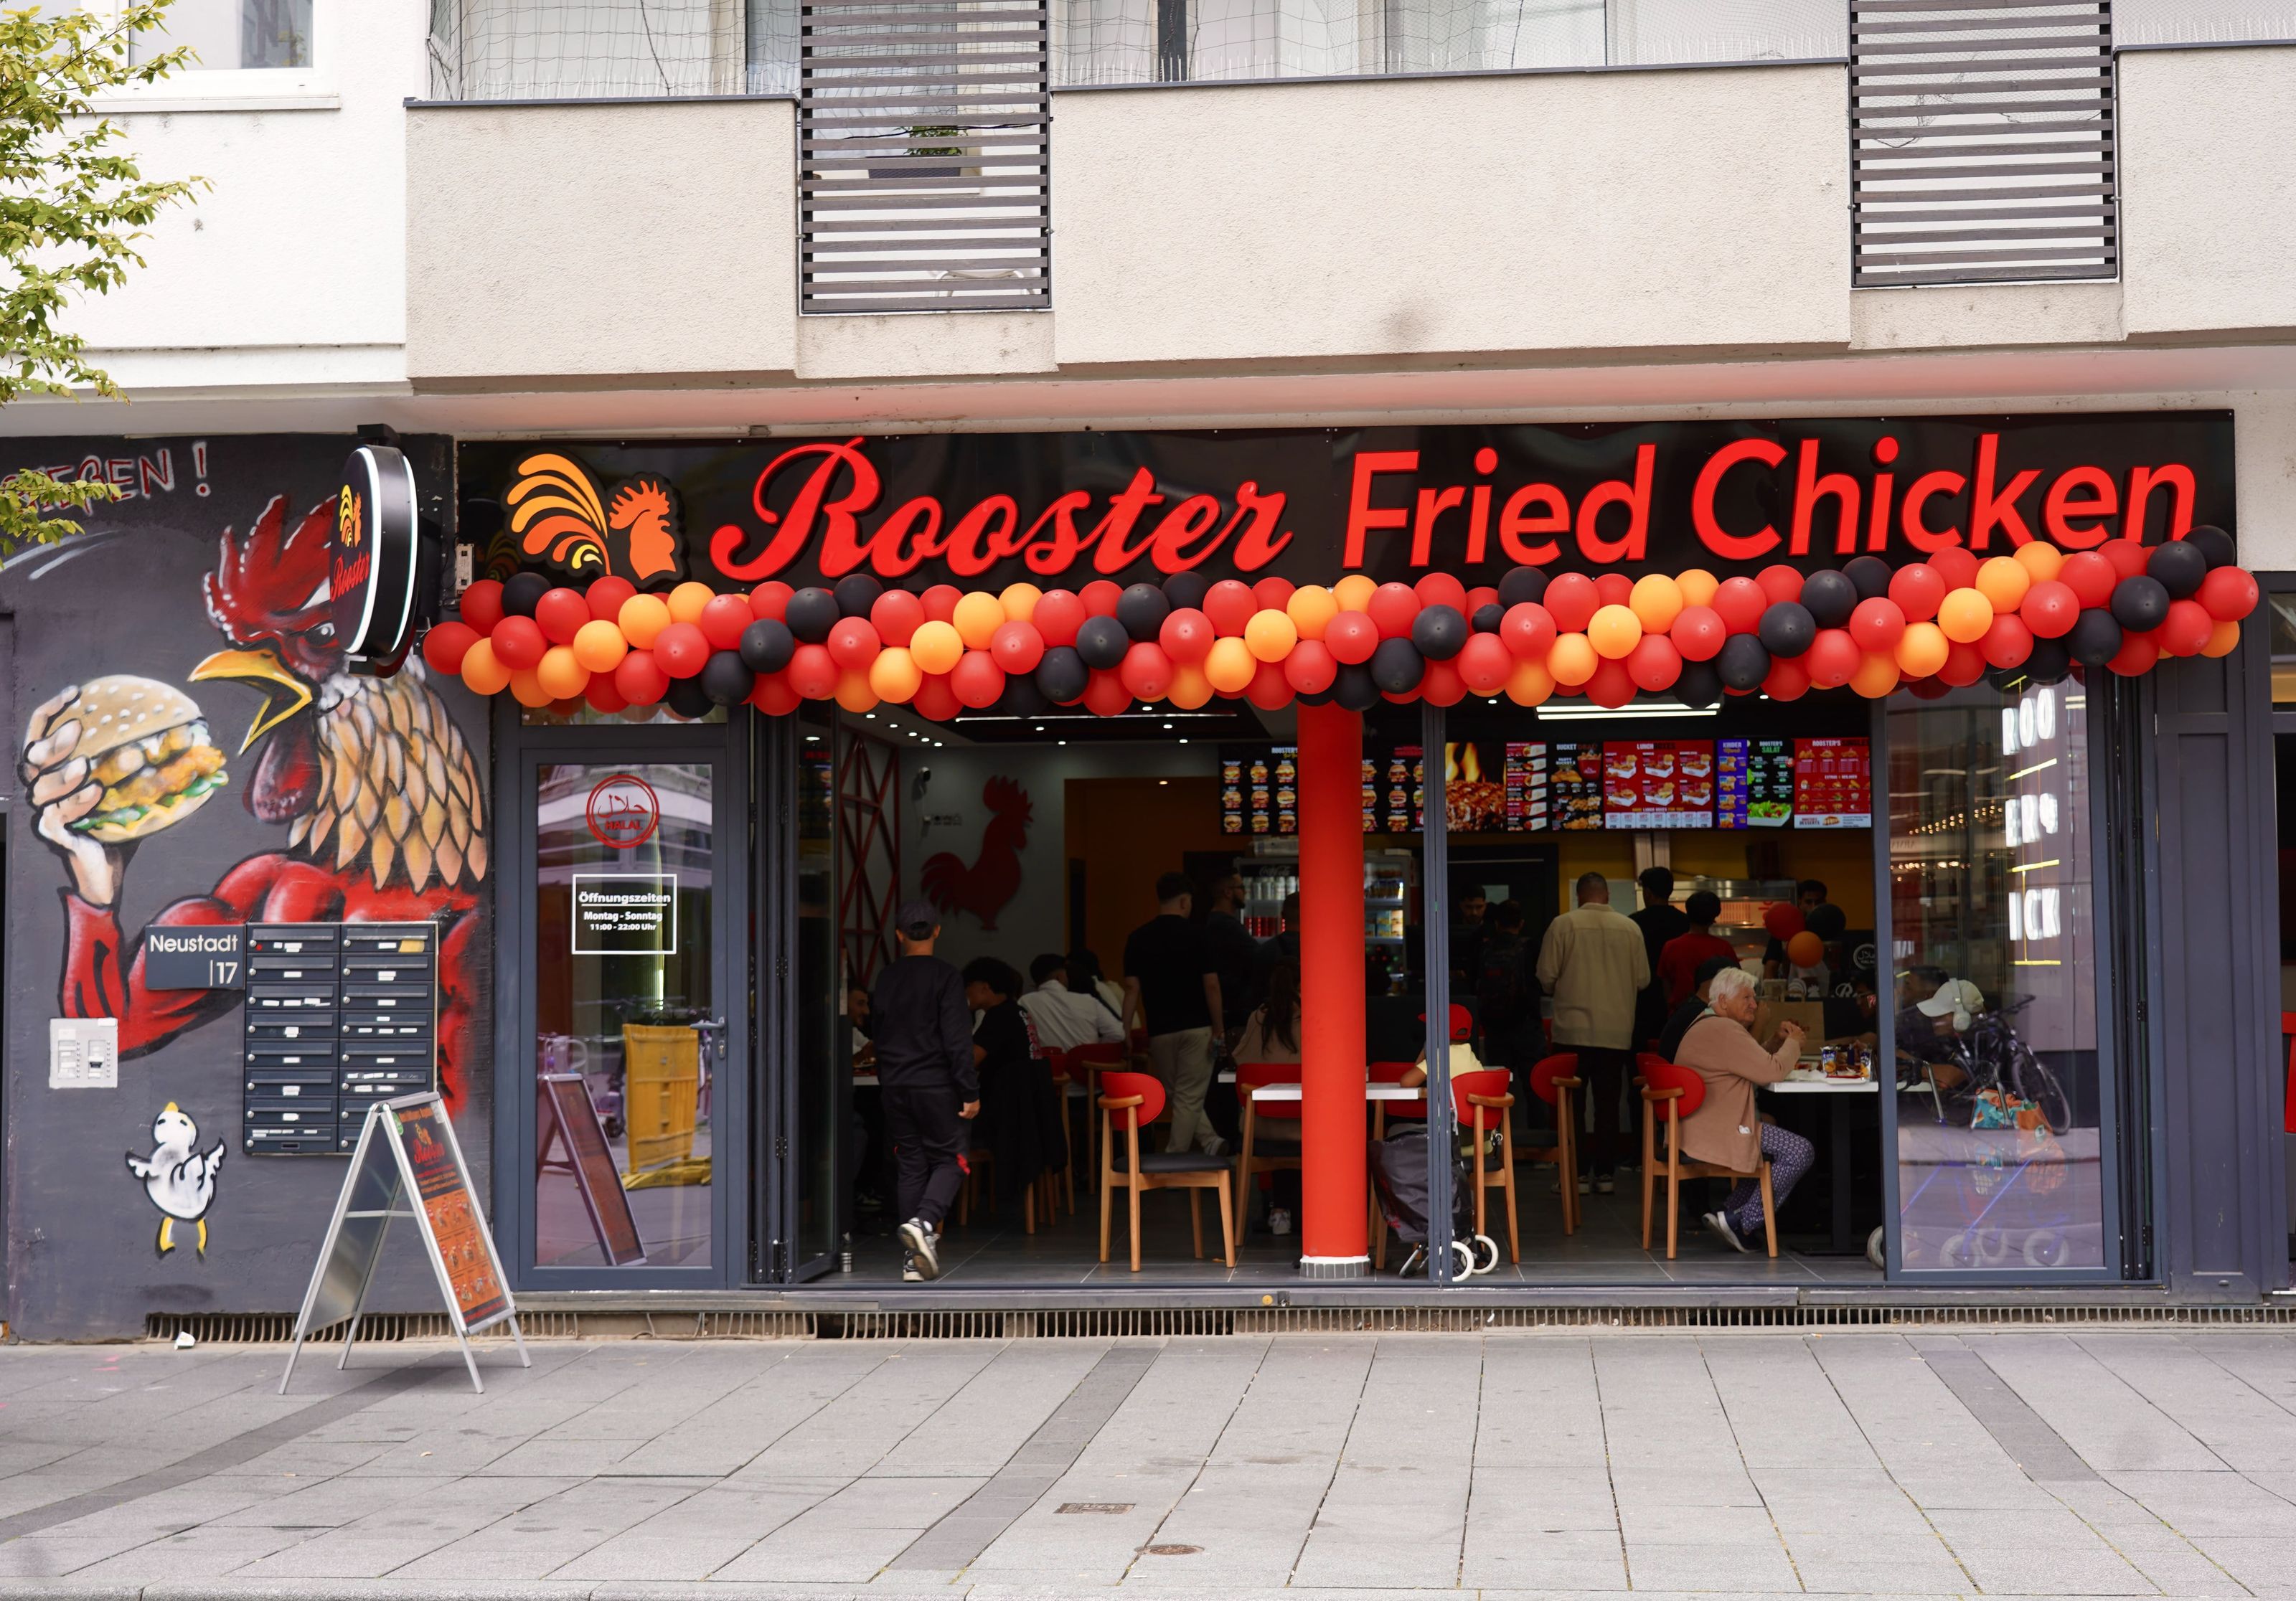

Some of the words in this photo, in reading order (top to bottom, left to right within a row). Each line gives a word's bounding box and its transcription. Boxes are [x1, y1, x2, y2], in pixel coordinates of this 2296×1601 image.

[707, 436, 1294, 582] Rooster
[1342, 443, 1657, 570] Fried
[1690, 433, 2197, 561] Chicken
[329, 550, 371, 603] Rooster
[597, 794, 648, 818] حلال
[605, 820, 642, 830] HALAL
[578, 892, 671, 905] Öffnungszeiten
[583, 911, 618, 922] Montag
[625, 911, 663, 922] Sonntag
[150, 934, 238, 953] Neustadt
